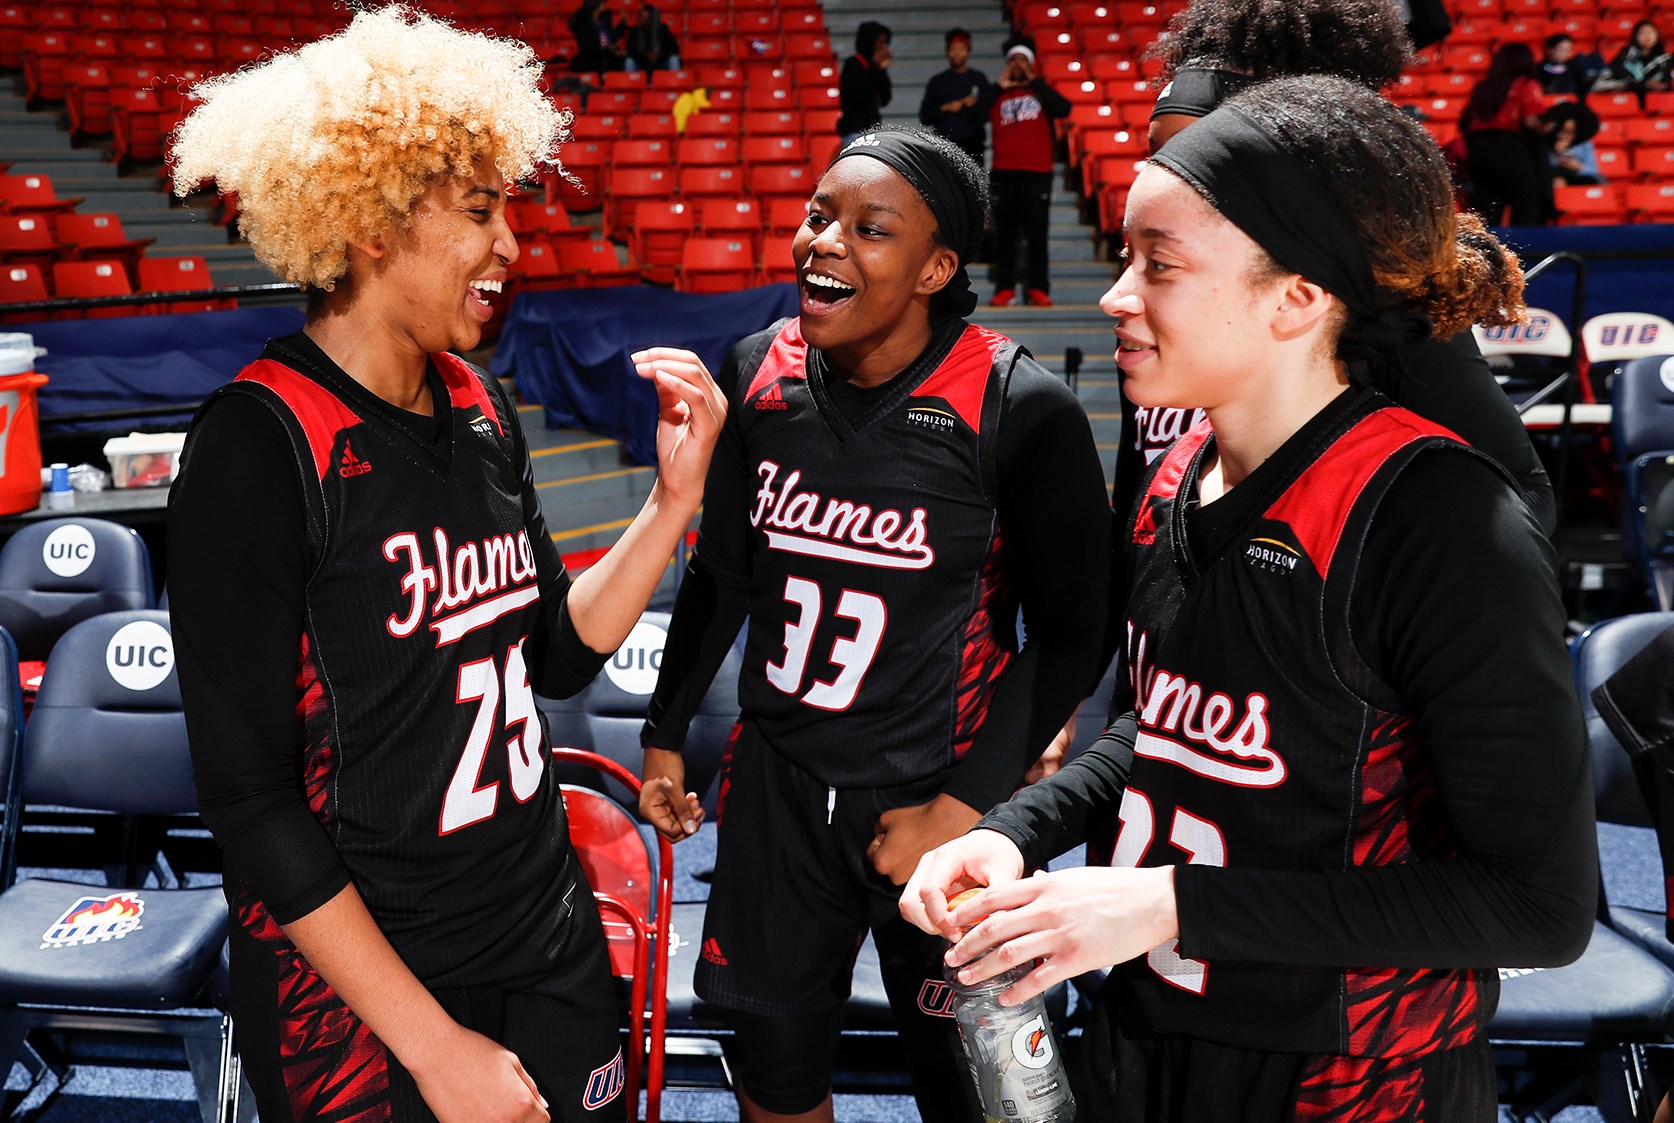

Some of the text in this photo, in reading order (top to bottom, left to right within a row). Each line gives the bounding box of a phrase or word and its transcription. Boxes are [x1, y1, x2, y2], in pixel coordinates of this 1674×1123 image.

[1600, 323, 1659, 346] UIC
[754, 400, 787, 410] adidas
[908, 412, 954, 428] HORIZON
[339, 461, 373, 478] adidas
[750, 459, 935, 569] Flames
[50, 543, 89, 559] UIC
[1246, 544, 1297, 570] HORIZON
[382, 526, 537, 639] Flame
[766, 575, 888, 711] 33
[114, 645, 168, 668] UIC
[1011, 1014, 1054, 1069] G
[583, 1050, 625, 1111] UI
